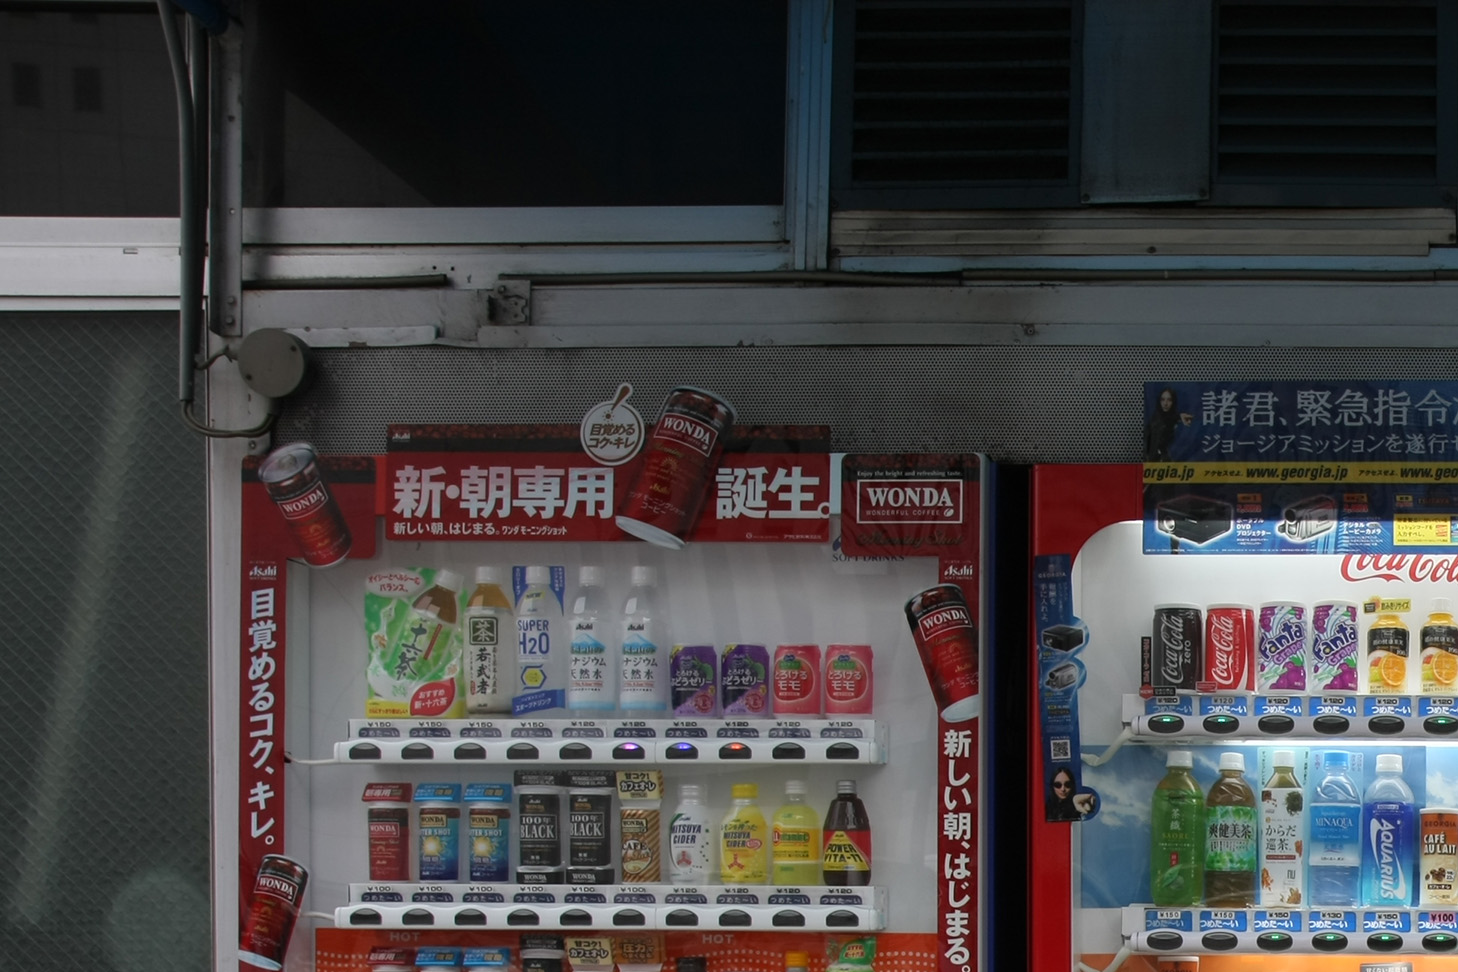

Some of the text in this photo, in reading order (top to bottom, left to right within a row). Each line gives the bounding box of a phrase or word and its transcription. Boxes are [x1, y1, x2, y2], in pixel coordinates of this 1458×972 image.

[663, 416, 711, 446] WONDA
[1246, 465, 1348, 481] www.georgia.jp
[281, 489, 325, 514] WONDA
[715, 466, 831, 520] 誕生。
[866, 487, 954, 507] WONDA
[249, 564, 277, 577] Asahi
[944, 564, 974, 577] Asahi
[517, 619, 549, 632] SUPER
[923, 609, 967, 631] WONDA
[472, 619, 496, 643] 茶
[1208, 822, 1251, 839] 爽健美茶
[259, 876, 295, 897] WONDA
[389, 931, 421, 942] HOT
[702, 934, 734, 945] HOT
